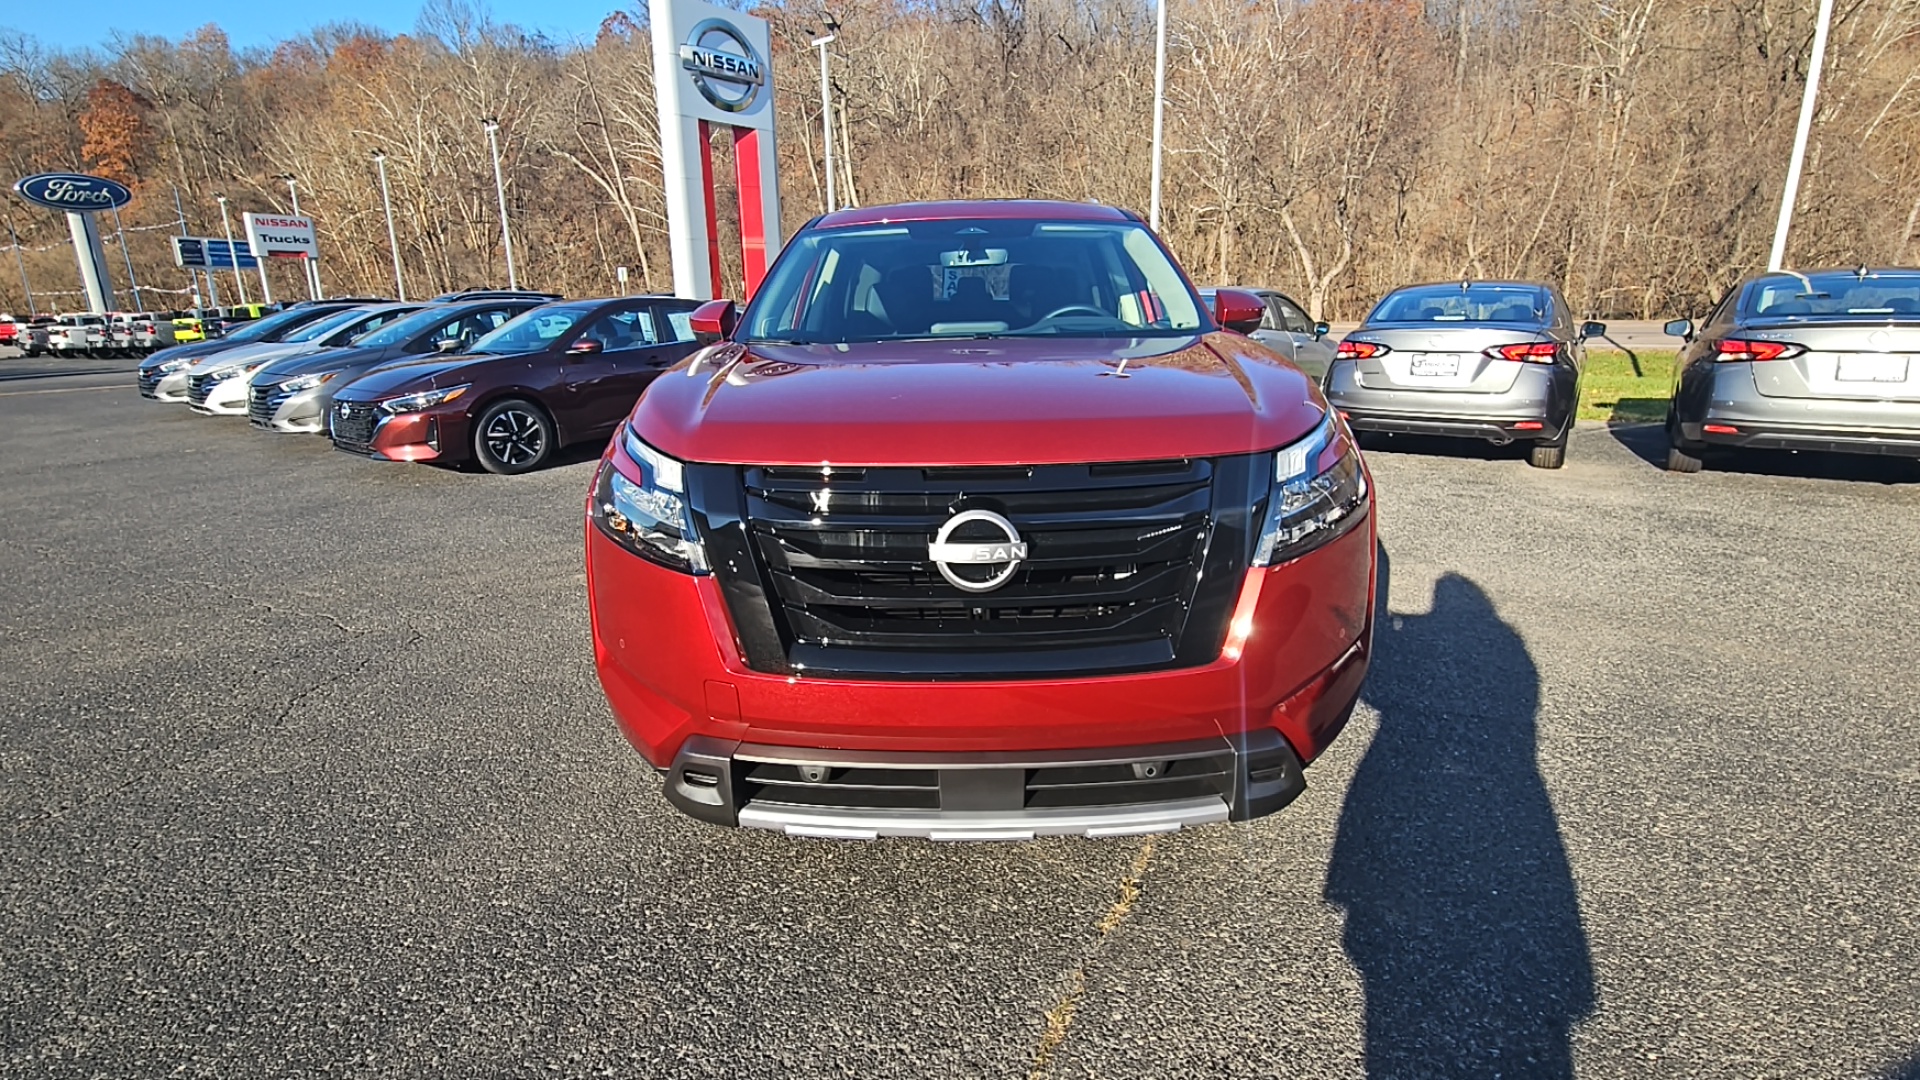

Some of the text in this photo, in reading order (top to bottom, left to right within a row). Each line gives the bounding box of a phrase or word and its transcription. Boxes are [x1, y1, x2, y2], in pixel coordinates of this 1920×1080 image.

[692, 50, 759, 79] NISSAN
[44, 179, 109, 203] Ford
[254, 217, 308, 229] NISSAN
[259, 233, 311, 245] Trucks
